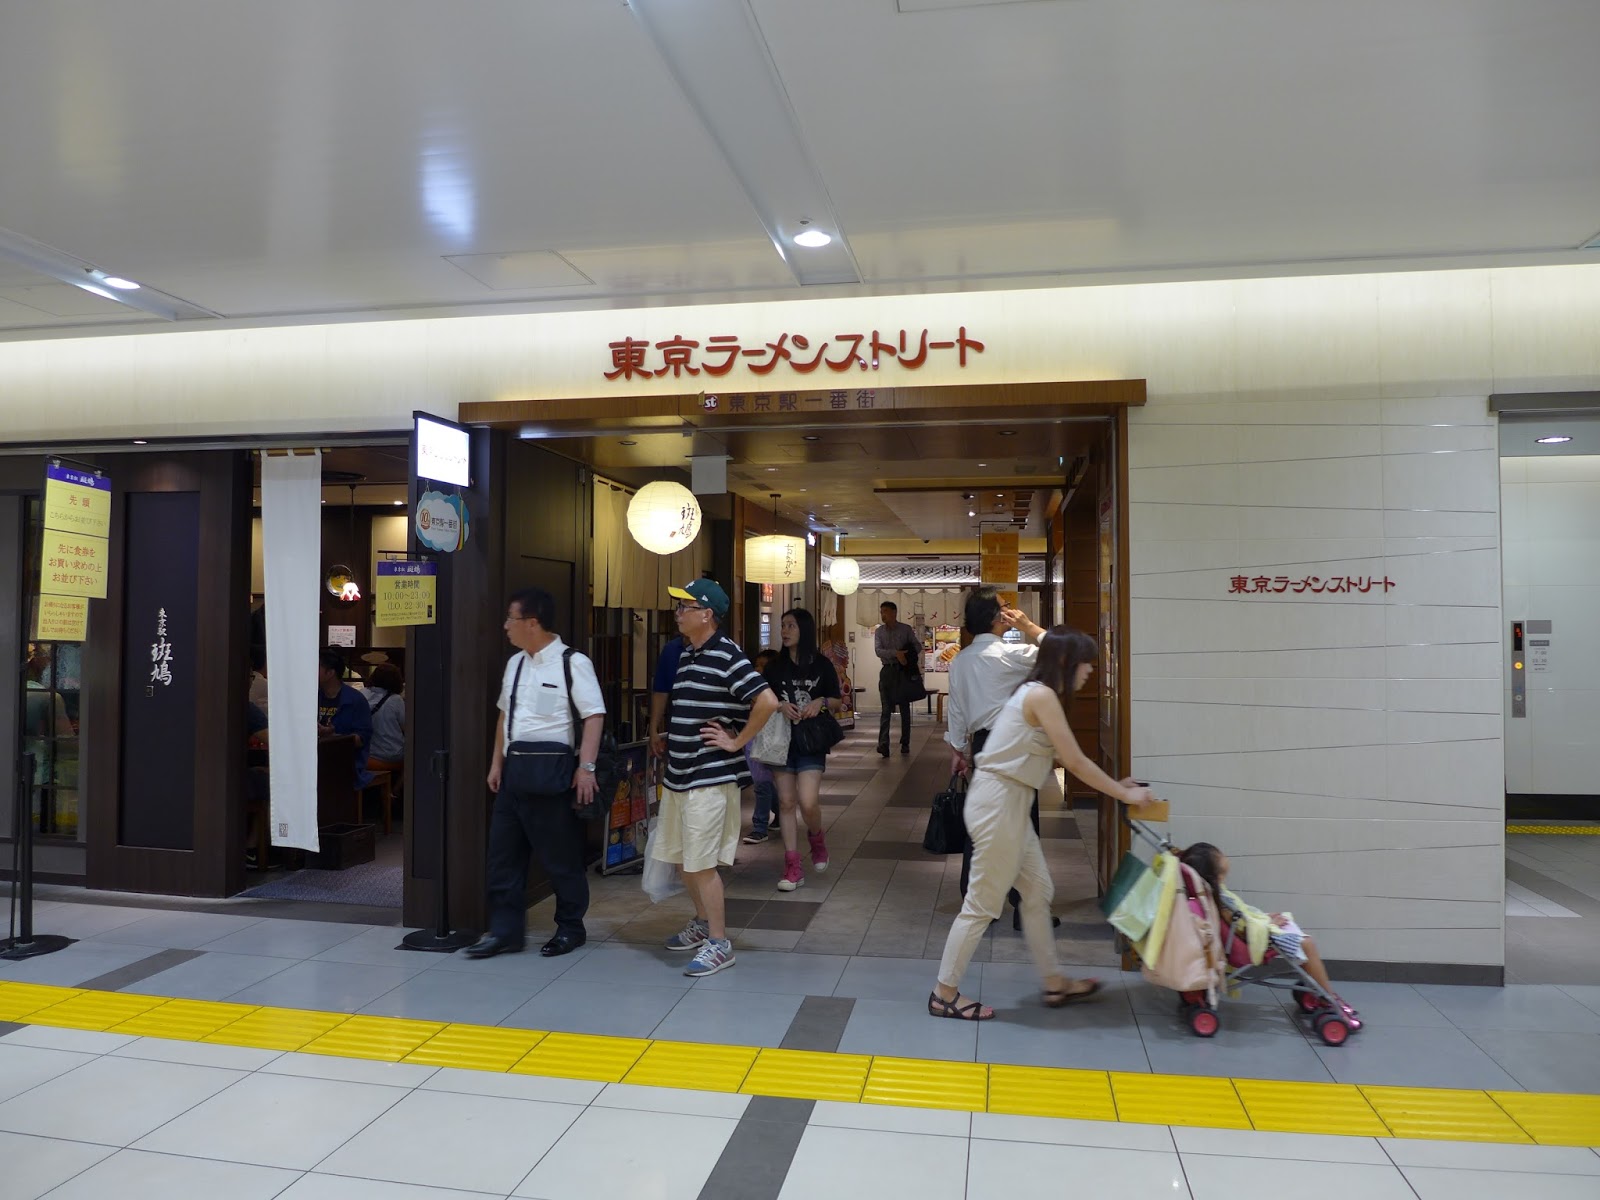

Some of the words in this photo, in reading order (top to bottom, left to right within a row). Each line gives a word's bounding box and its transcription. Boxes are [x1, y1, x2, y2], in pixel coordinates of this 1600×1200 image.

[603, 326, 985, 380] 東京ラーメンストリート
[729, 390, 876, 412] 東京駅一番街
[58, 544, 96, 557] 先に食券を
[49, 558, 103, 573] お買い求めの上
[52, 573, 98, 586] お並び下さい
[395, 580, 420, 590] 営業時間
[1228, 575, 1396, 593] 東京ラーメンストリート
